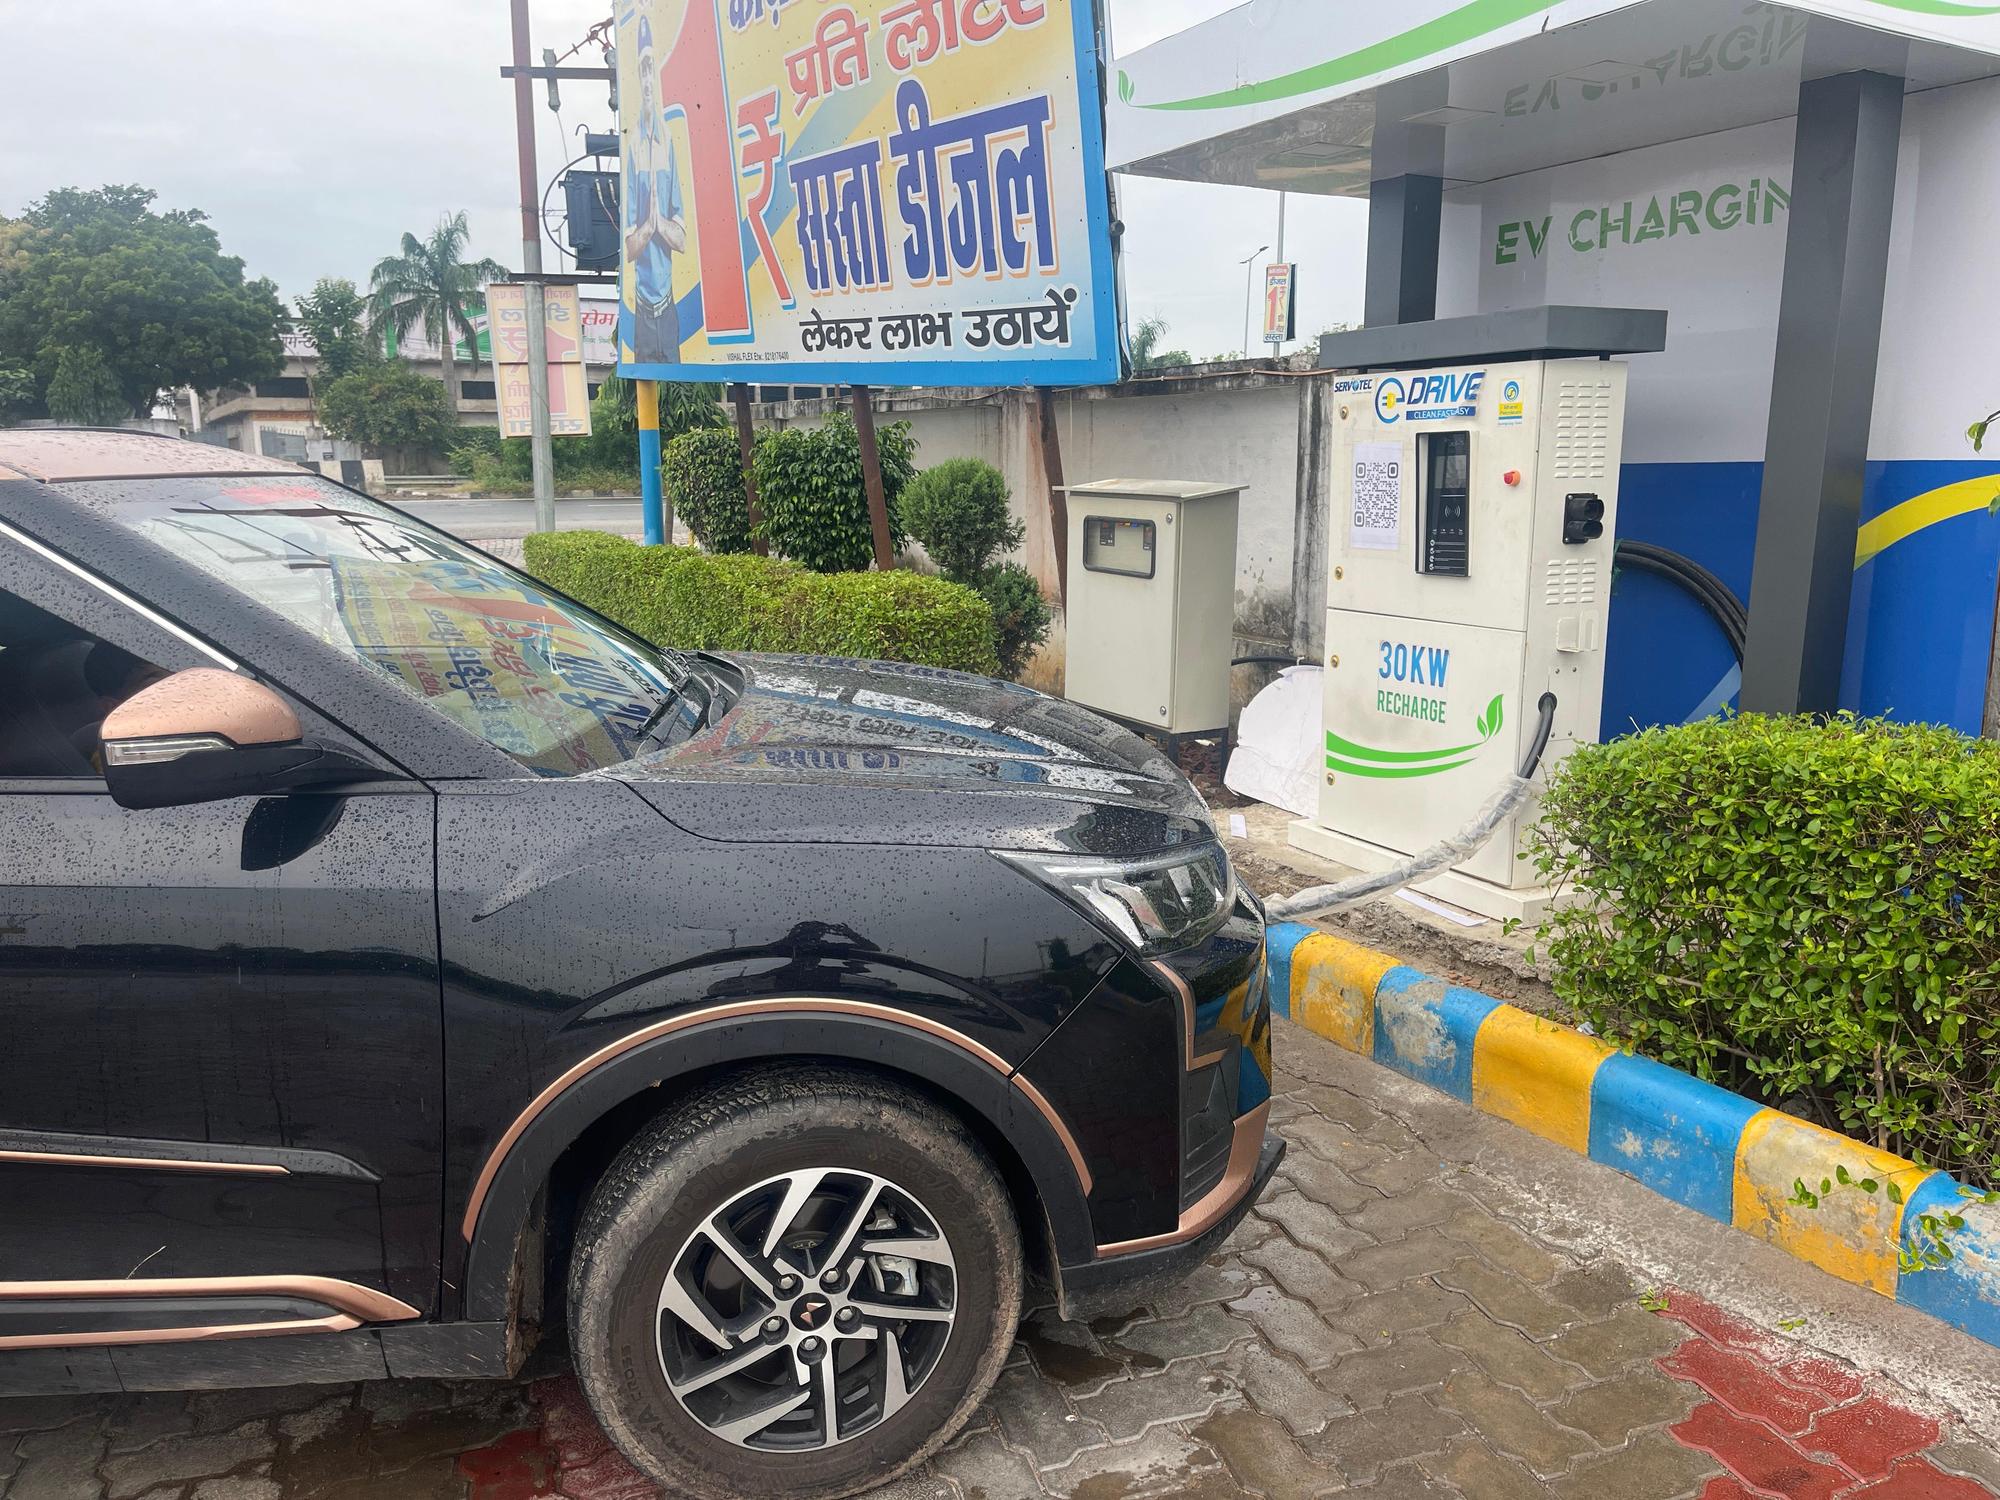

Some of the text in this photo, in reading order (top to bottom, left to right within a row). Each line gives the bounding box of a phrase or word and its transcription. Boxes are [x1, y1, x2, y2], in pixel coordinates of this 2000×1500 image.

[785, 7, 869, 117] प्रति
[789, 79, 1055, 291] सस्ता डीजल
[1495, 215, 1553, 265] EV
[800, 288, 1078, 352] लेकर लाभ उठायें
[1378, 640, 1450, 688] 30KW
[1377, 689, 1447, 724] RECHARGE
